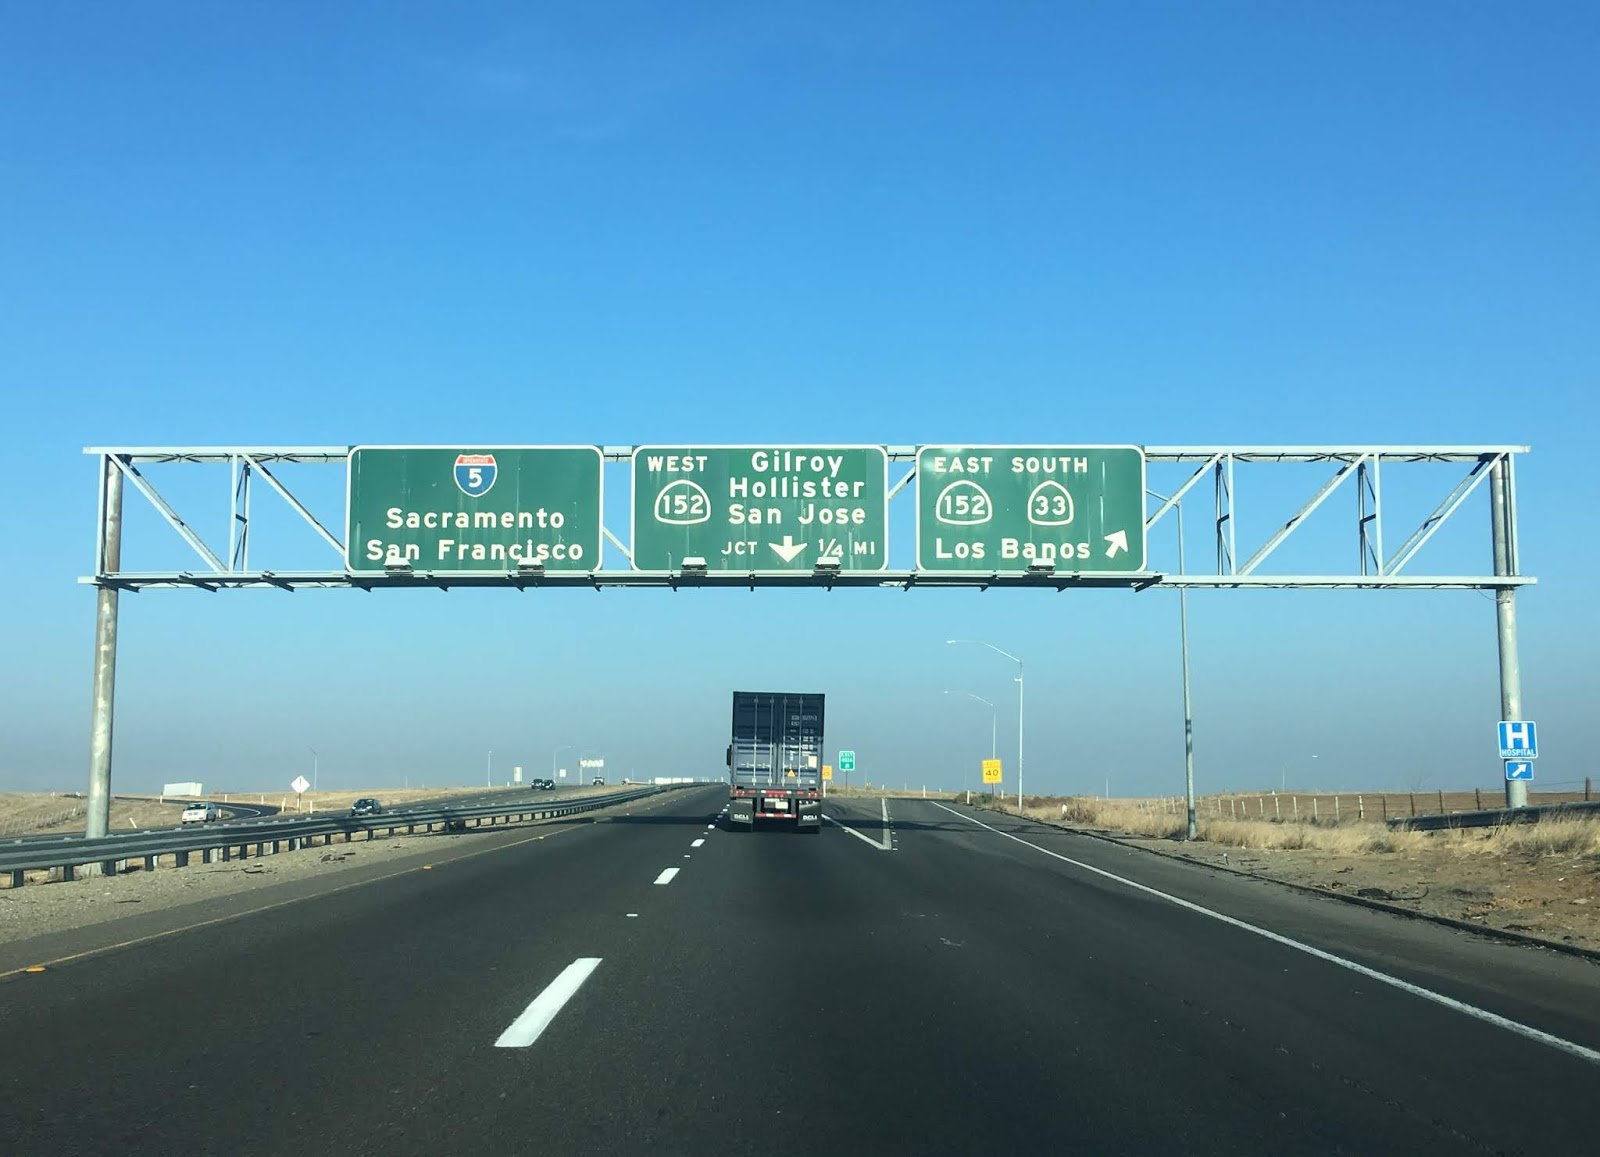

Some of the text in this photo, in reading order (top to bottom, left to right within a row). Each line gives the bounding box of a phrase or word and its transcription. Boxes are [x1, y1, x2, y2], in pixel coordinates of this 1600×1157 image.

[648, 456, 707, 471] WEST
[752, 450, 843, 477] Gilroy
[934, 457, 993, 473] EAST
[1012, 457, 1087, 473] SOUTH
[469, 468, 482, 487] 5
[730, 476, 864, 498] Hollister
[663, 495, 703, 514] 152
[729, 504, 865, 524] San Jose
[944, 496, 985, 515] 152
[1035, 496, 1066, 515] 33
[387, 508, 564, 528] Sacramento
[367, 539, 583, 560] San Francisco
[722, 542, 757, 555] JCT
[855, 542, 874, 554] MI
[937, 538, 1090, 559] Los Banos
[1505, 723, 1530, 749] H
[1501, 748, 1536, 757] HOSPITAL
[985, 769, 999, 777] 40
